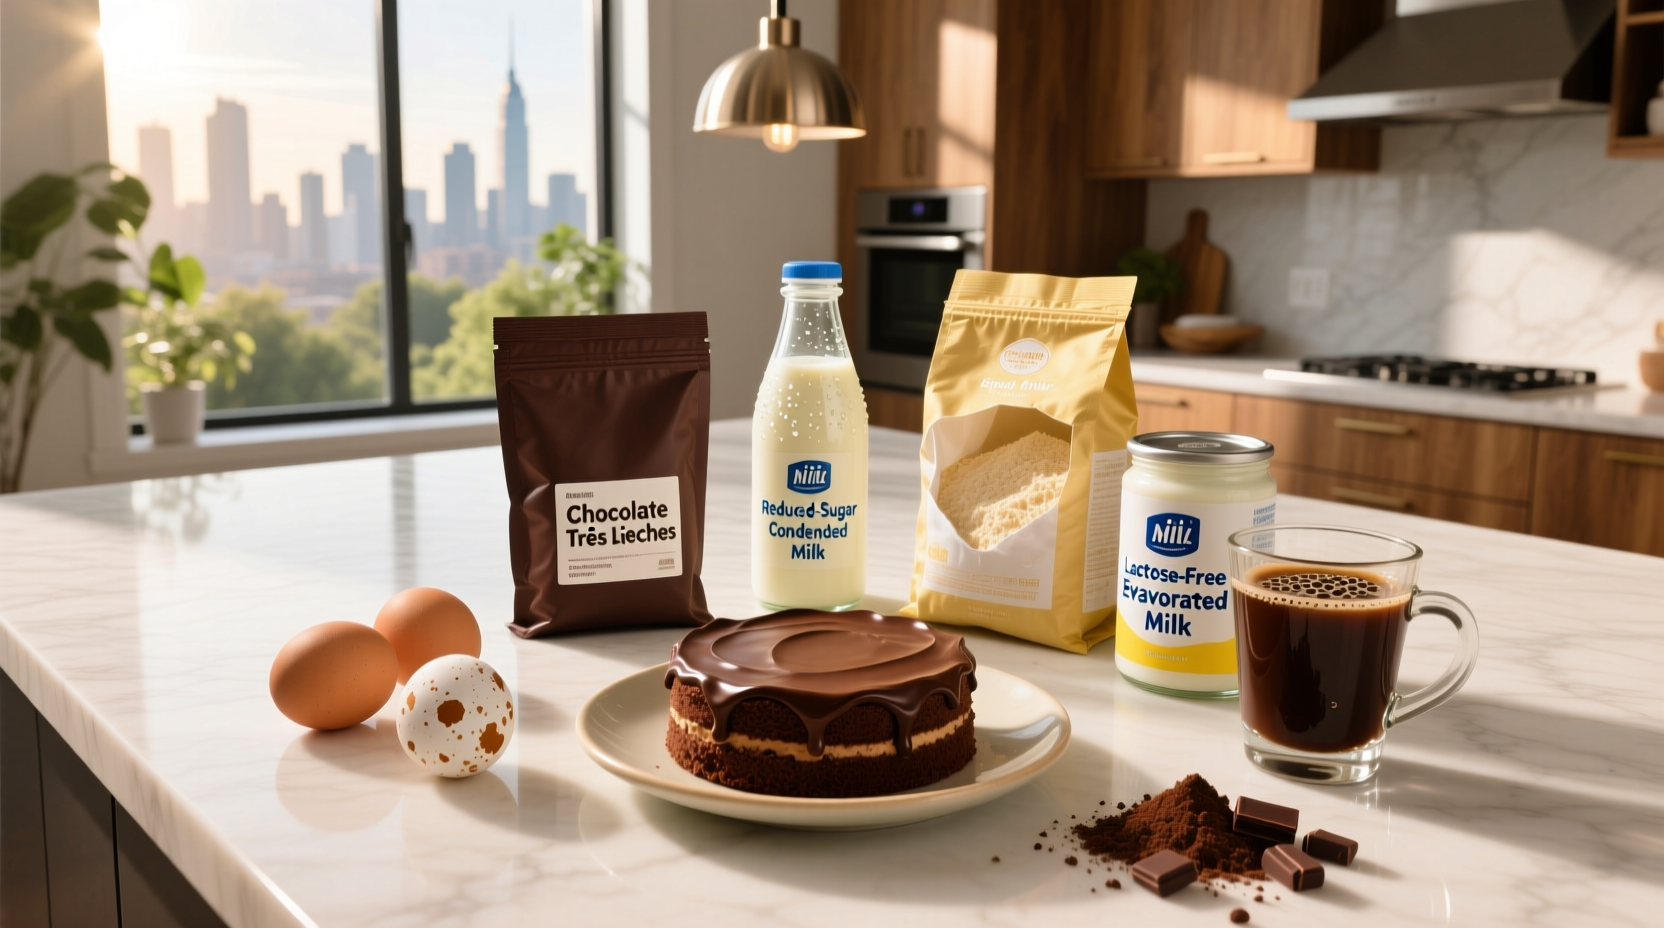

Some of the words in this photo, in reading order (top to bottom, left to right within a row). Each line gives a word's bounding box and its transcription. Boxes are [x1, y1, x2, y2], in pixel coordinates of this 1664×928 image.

[566, 500, 668, 524] Chocolate
[762, 500, 857, 521] Reduced-Sugar
[612, 523, 676, 545] Lieches
[769, 521, 847, 540] Condended
[791, 543, 825, 560] Milk
[1125, 556, 1227, 586] Lactose-Free
[1122, 578, 1228, 610] Evavorated
[1145, 610, 1192, 636] Milk
